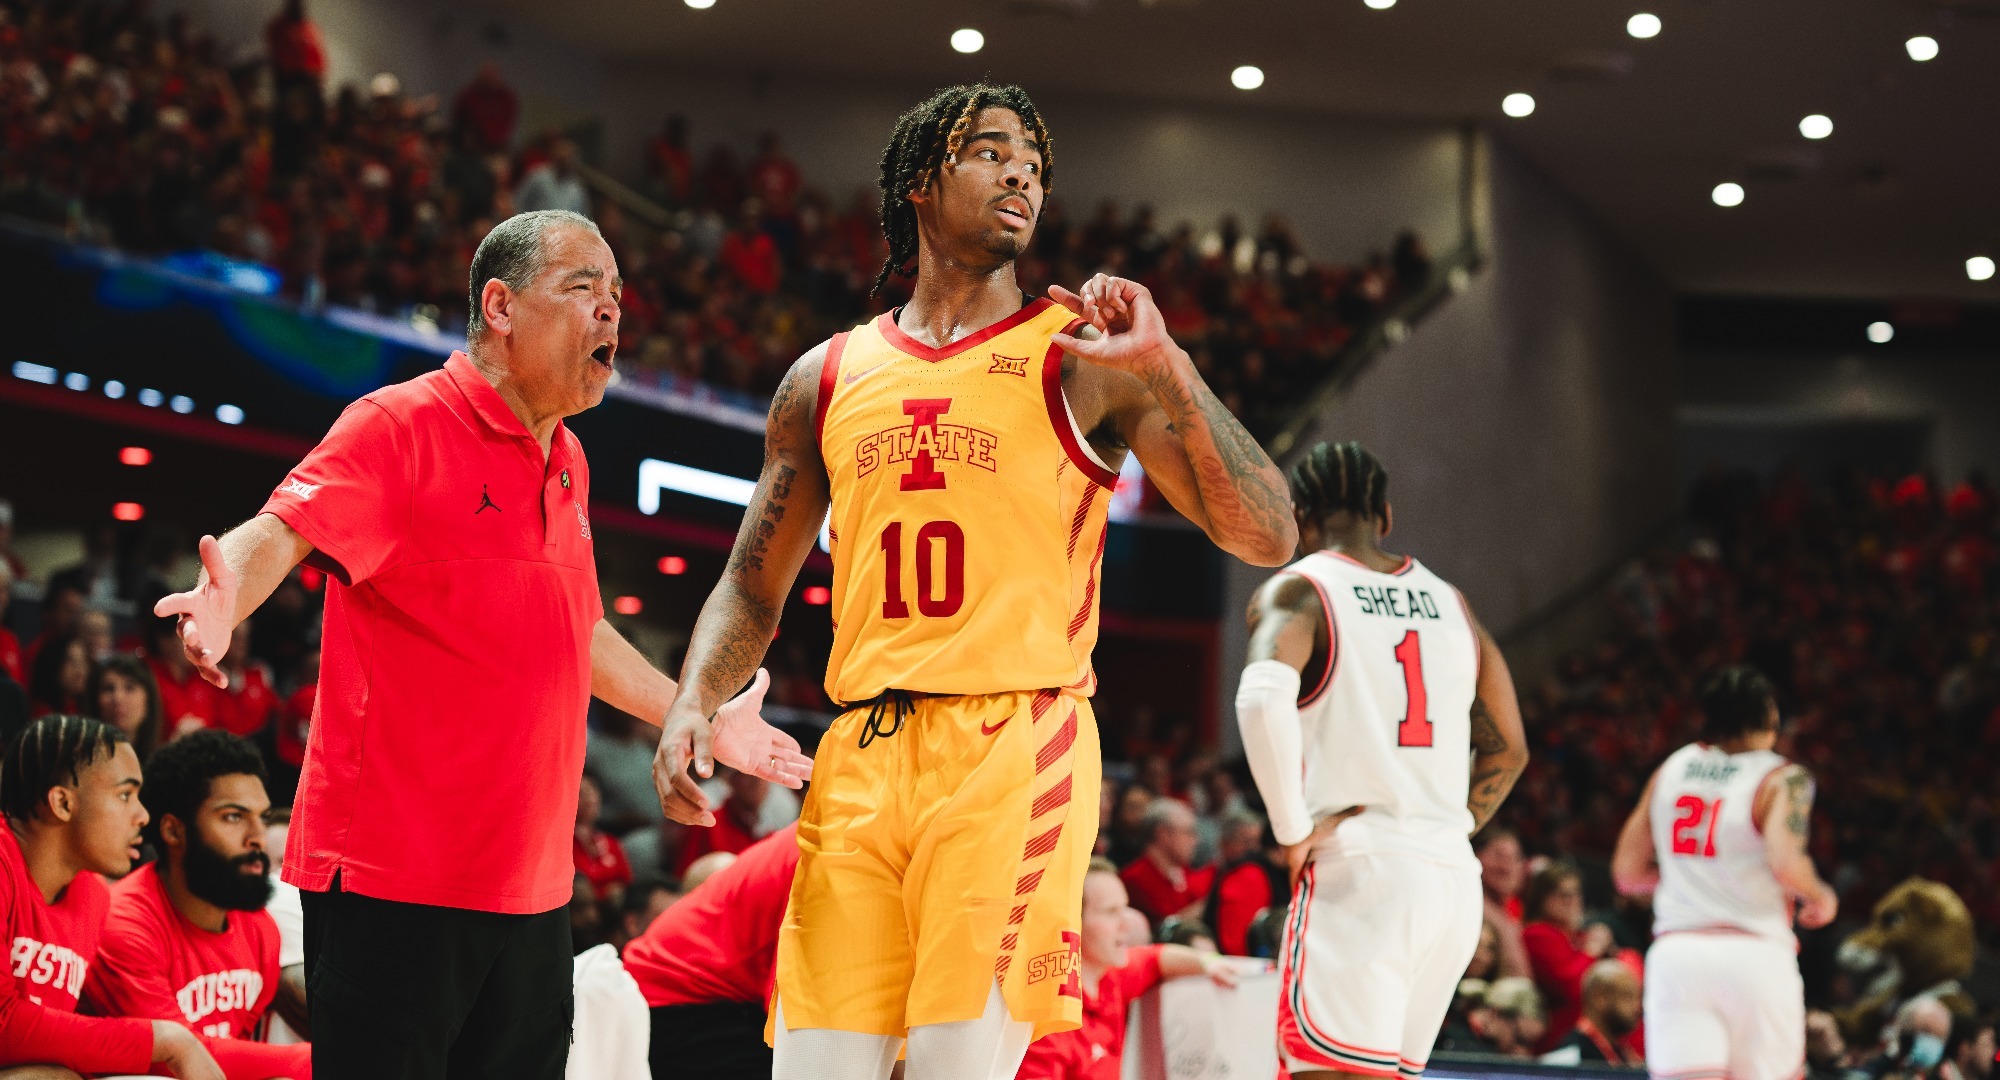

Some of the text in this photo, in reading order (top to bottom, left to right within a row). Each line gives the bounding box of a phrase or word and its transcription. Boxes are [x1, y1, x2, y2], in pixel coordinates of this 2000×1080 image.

[988, 353, 1030, 377] XII
[856, 424, 998, 479] STATE
[880, 521, 964, 619] 10
[1353, 586, 1440, 619] SHEAD
[1394, 629, 1433, 747] 1
[1672, 794, 1723, 858] 21
[1027, 948, 1081, 986] STA
